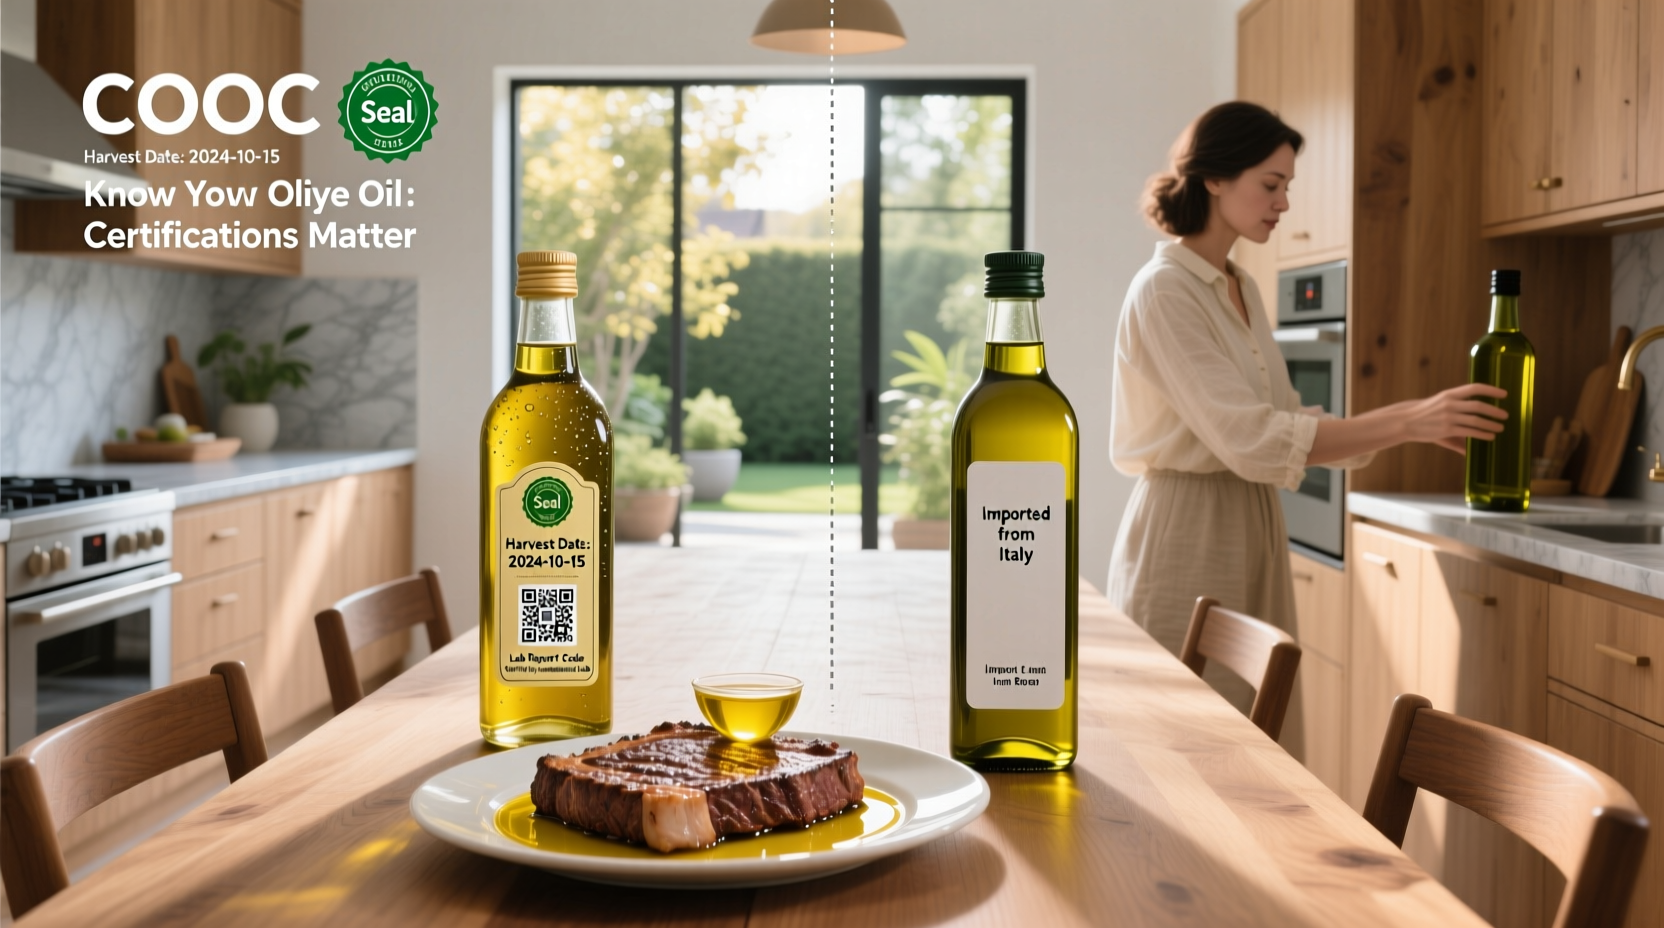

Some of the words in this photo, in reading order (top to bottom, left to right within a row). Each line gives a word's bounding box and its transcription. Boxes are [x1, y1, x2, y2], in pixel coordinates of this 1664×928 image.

[982, 505, 1051, 525] Imported
[998, 526, 1035, 541] from
[505, 537, 555, 550] Harvest
[508, 554, 586, 568] 2024-10-15
[999, 546, 1034, 566] Italy
